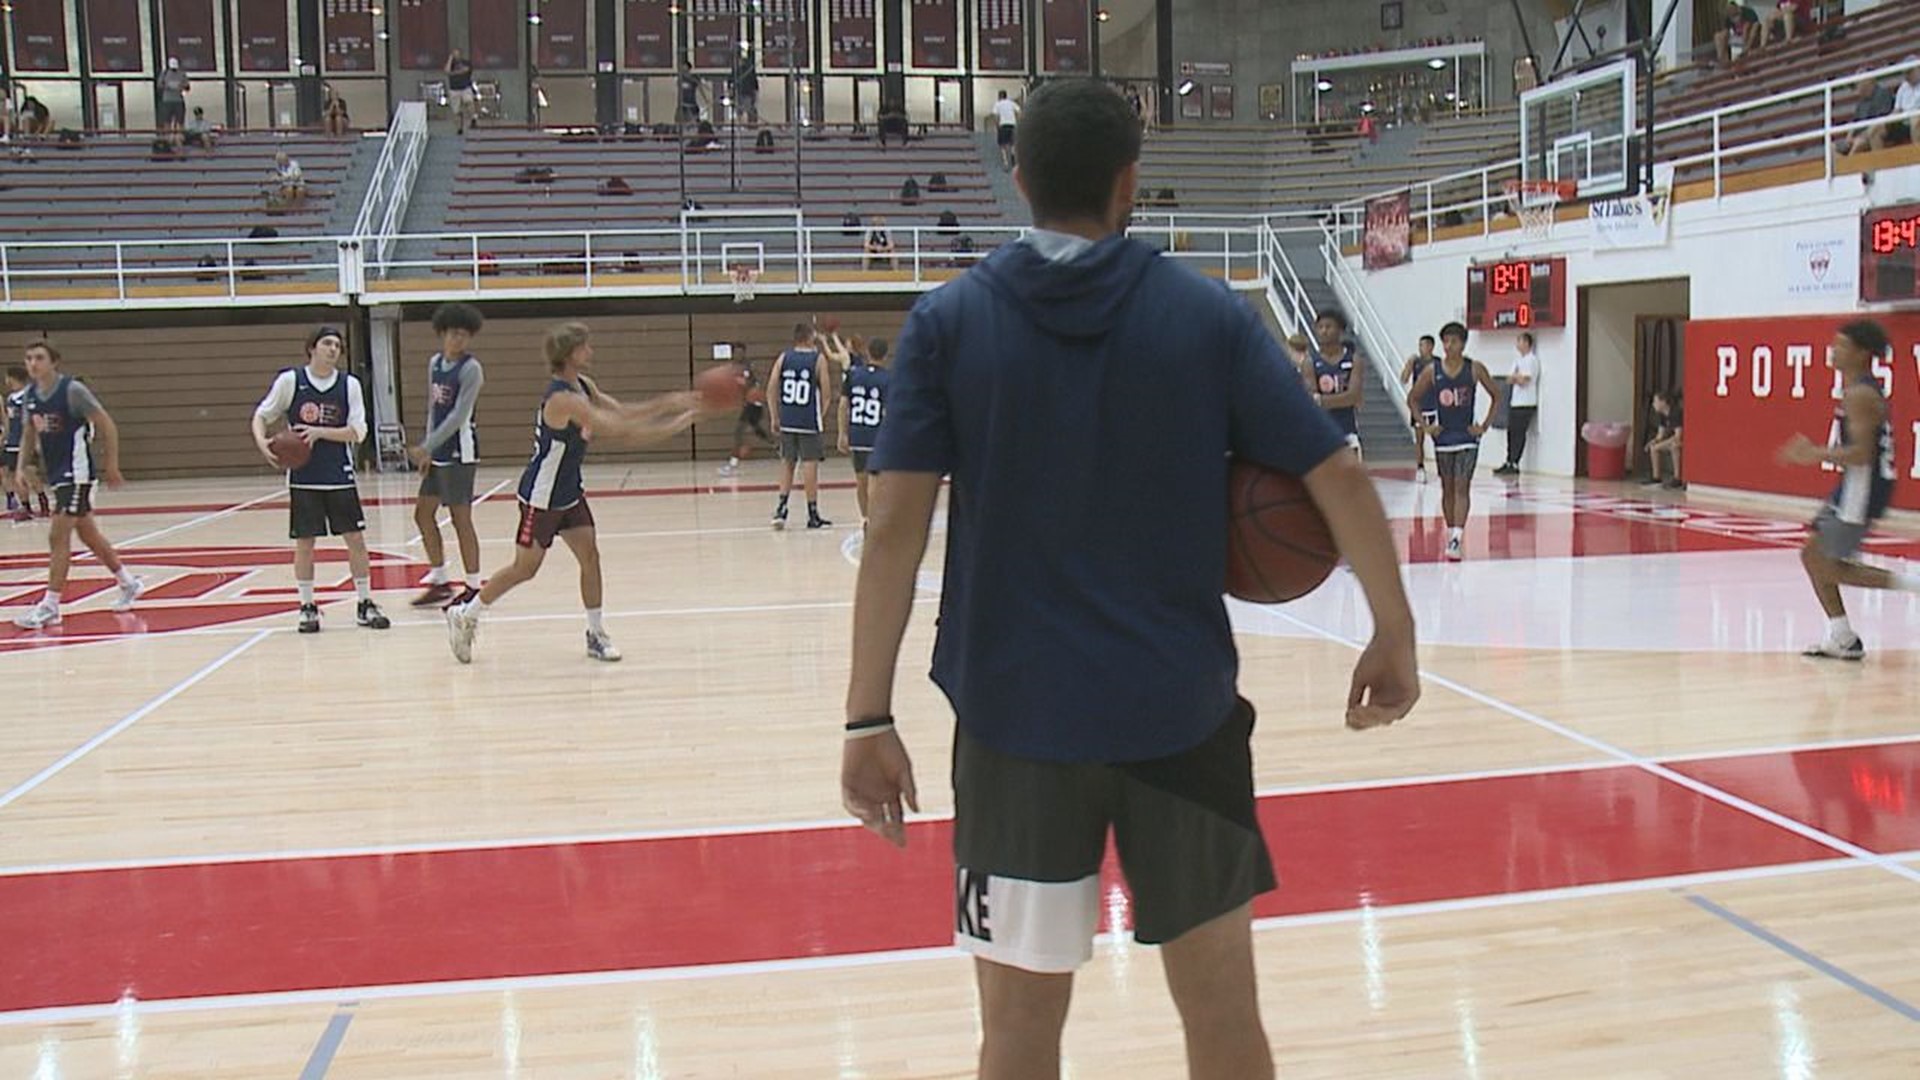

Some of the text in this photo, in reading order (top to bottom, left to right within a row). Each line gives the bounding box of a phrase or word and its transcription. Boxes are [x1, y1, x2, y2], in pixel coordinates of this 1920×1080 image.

[1874, 216, 1920, 252] 13:4
[1519, 303, 1528, 326] 0
[782, 379, 810, 405] 90
[851, 396, 881, 426] 29
